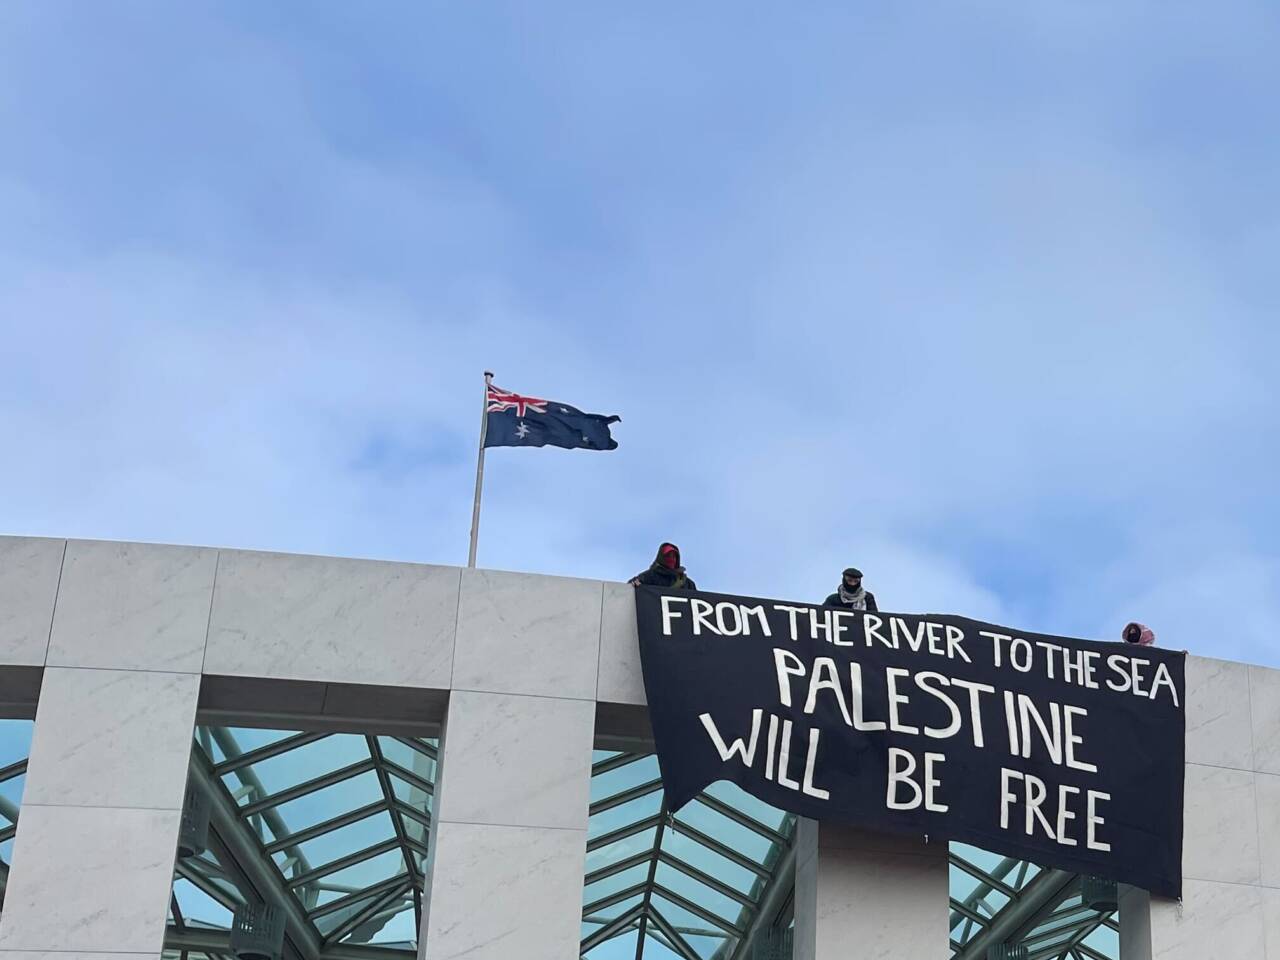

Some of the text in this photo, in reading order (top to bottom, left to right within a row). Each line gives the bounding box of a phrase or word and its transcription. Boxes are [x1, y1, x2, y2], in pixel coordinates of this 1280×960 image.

[660, 595, 1180, 708] FROM THE RIVER TO THE SEA
[772, 647, 1098, 773] PALESTINE
[699, 708, 1111, 852] WILL BE FREE
